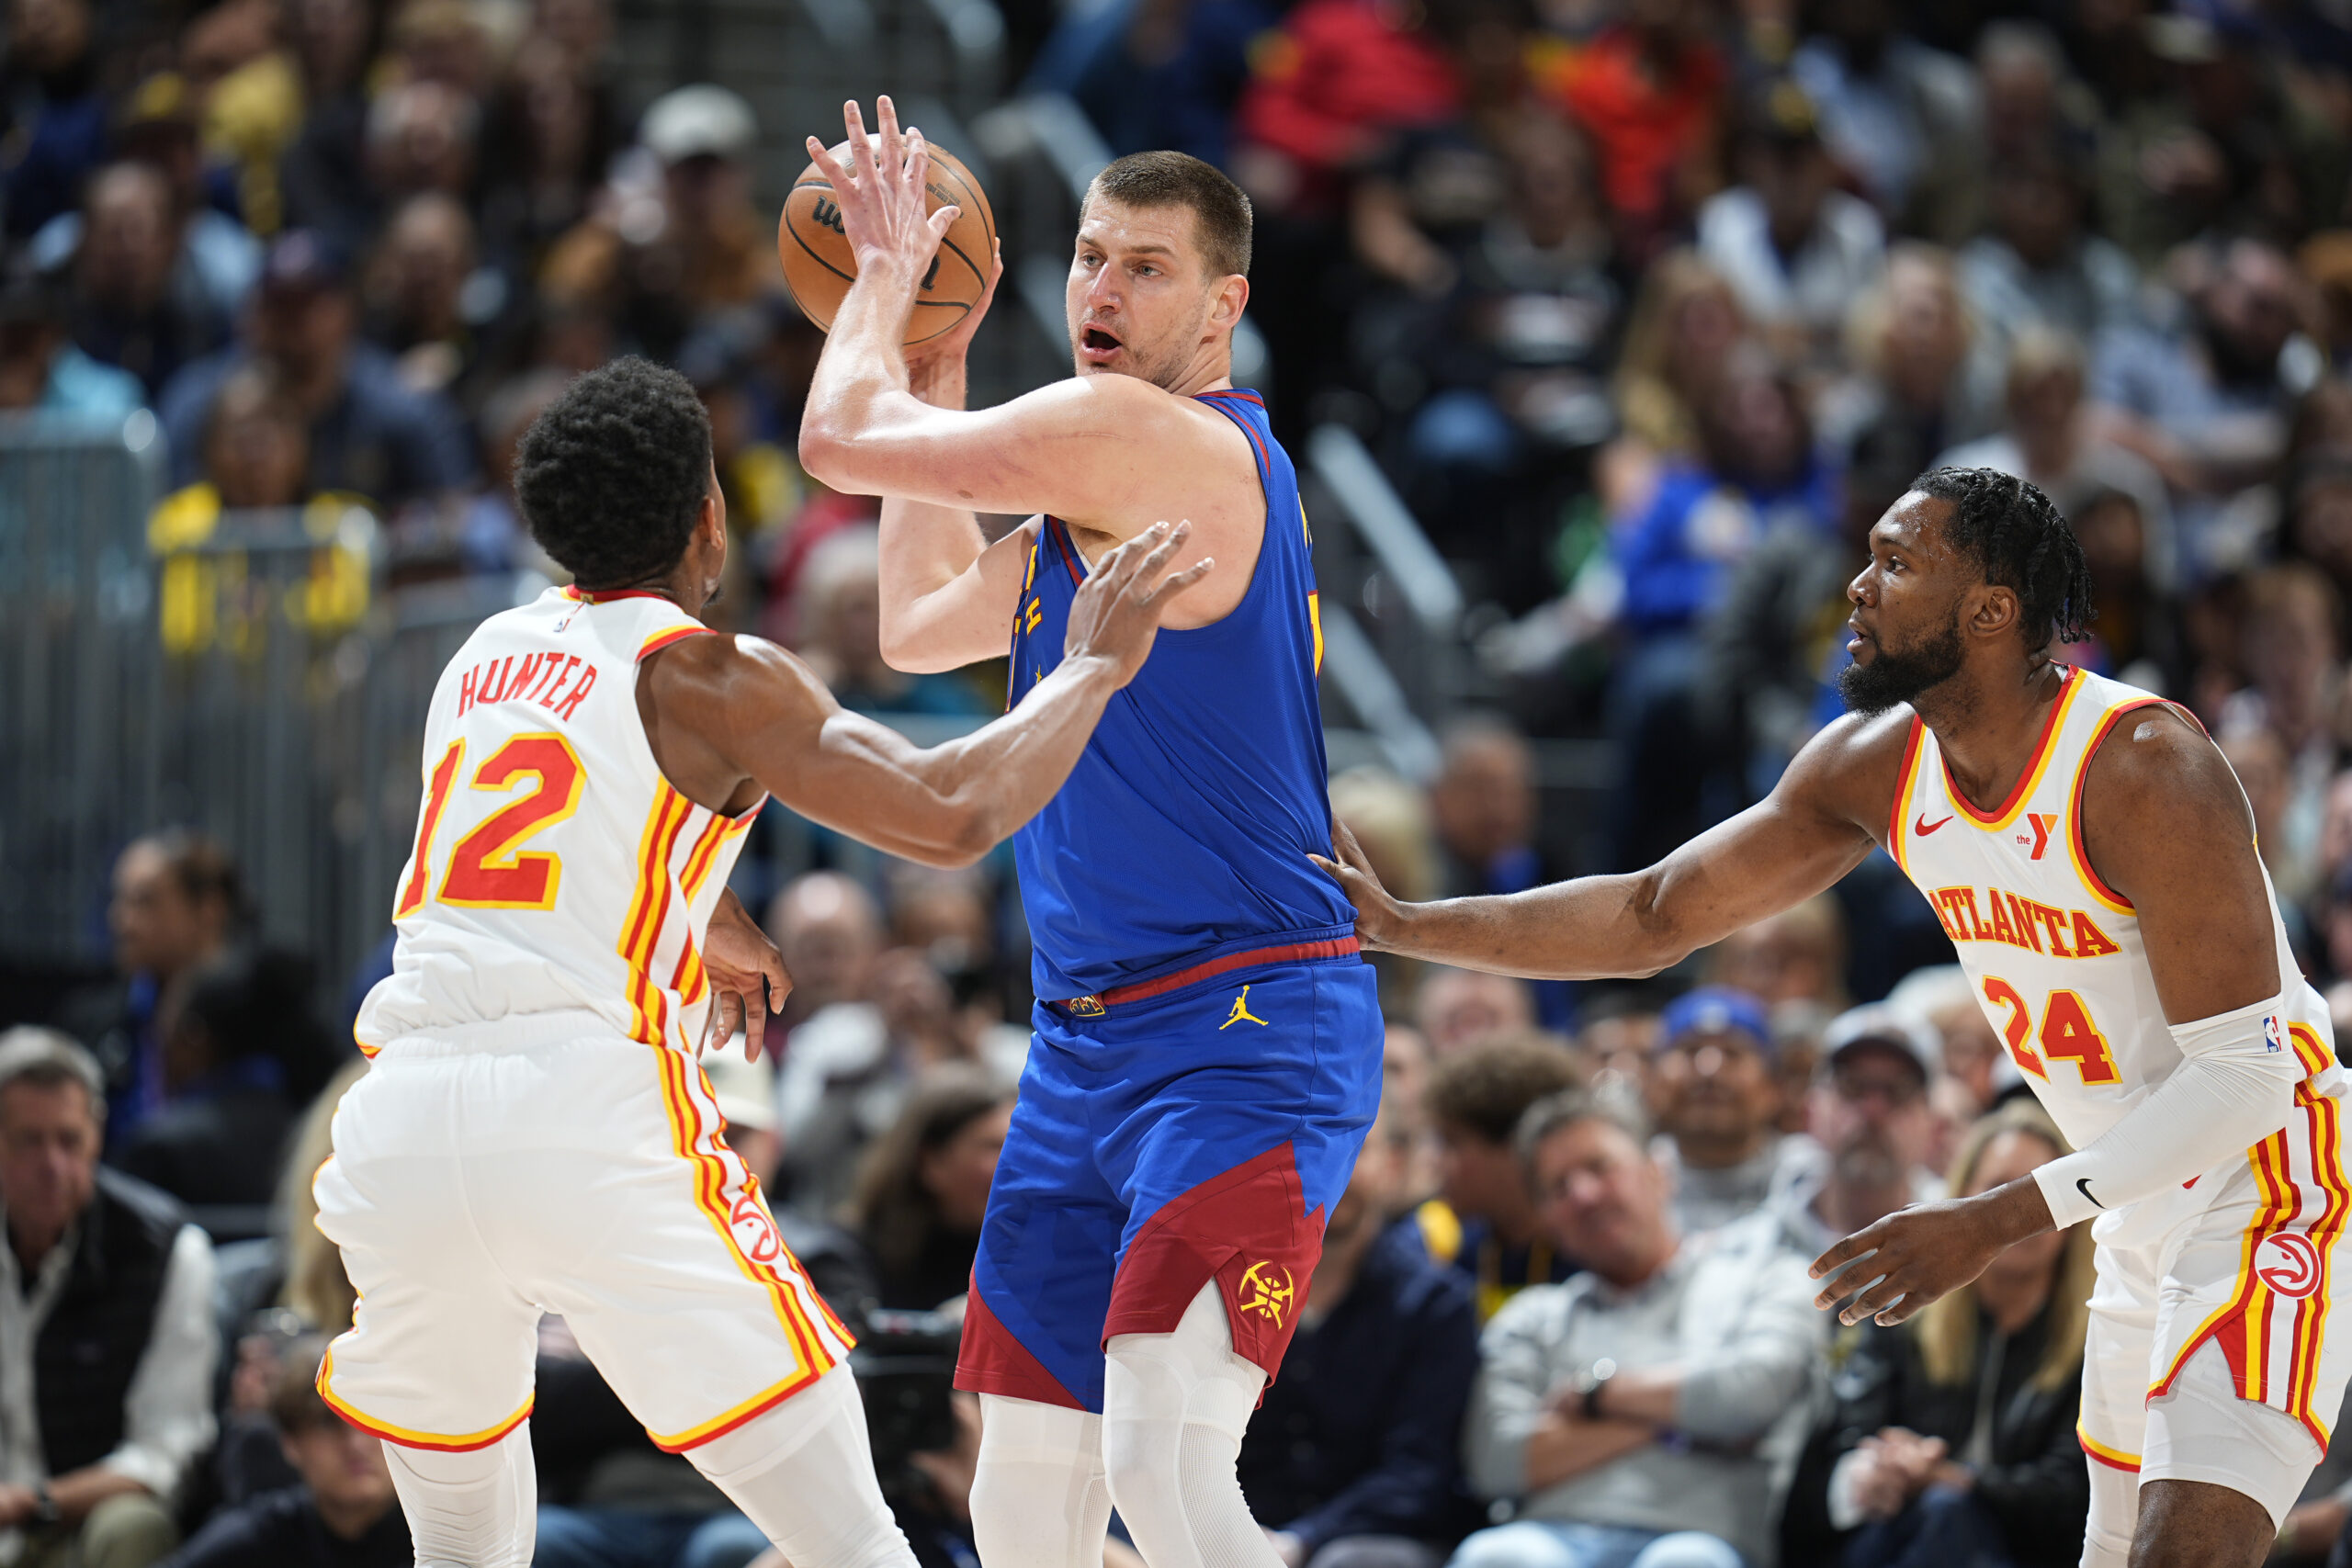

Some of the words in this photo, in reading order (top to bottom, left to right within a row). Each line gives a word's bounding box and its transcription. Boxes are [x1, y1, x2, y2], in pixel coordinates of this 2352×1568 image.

[457, 652, 597, 722] HUNTER
[391, 731, 588, 920] 12
[2016, 834, 2030, 845] the
[1928, 886, 2122, 959] ATLANTA
[1982, 975, 2123, 1086] 24
